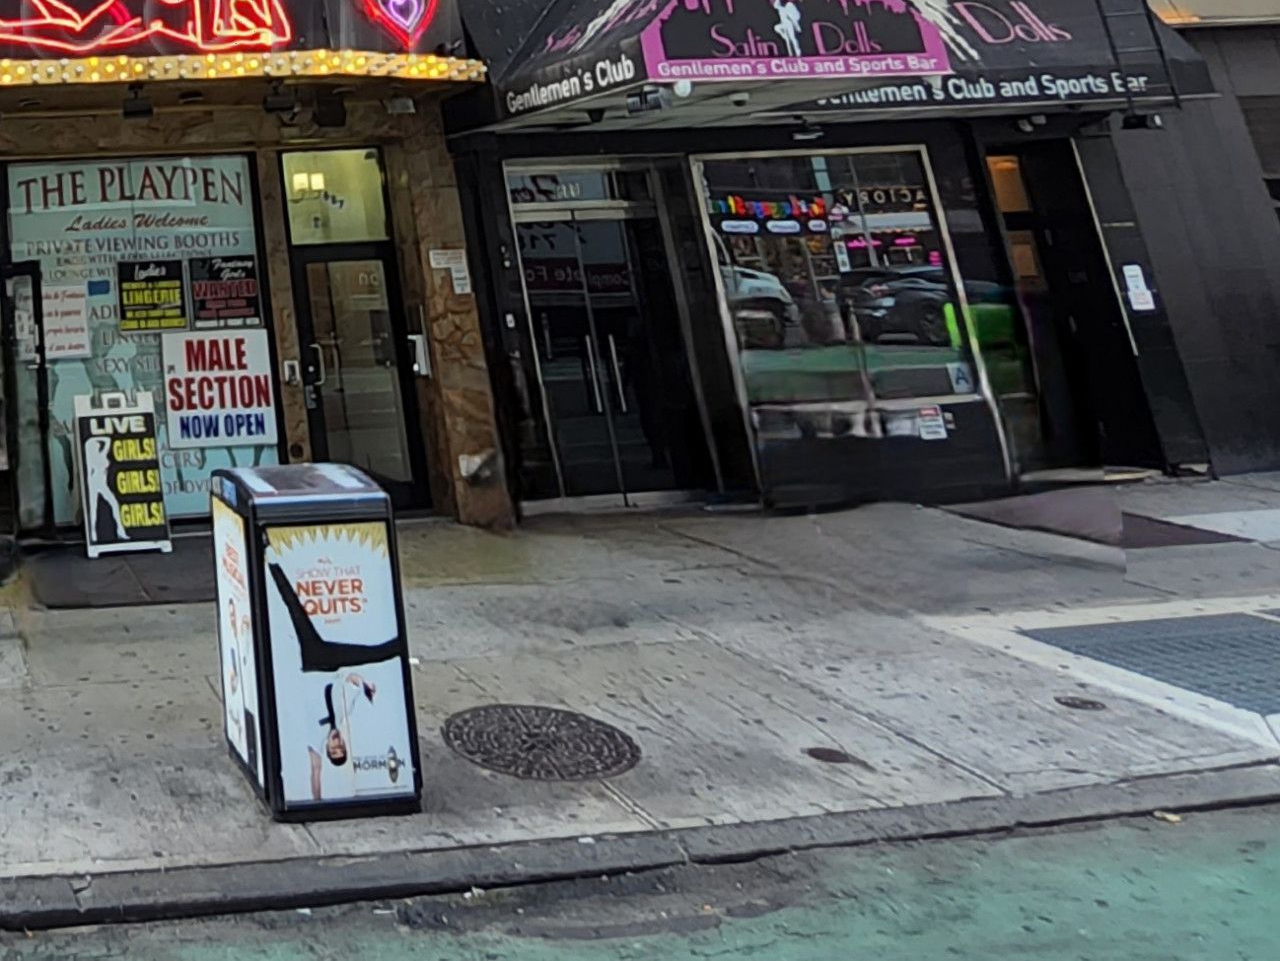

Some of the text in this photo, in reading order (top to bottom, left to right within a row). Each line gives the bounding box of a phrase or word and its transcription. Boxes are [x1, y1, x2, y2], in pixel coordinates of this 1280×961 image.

[953, 0, 1073, 43] Dolls
[710, 21, 883, 57] Satin Dolls
[595, 53, 635, 87] Club
[770, 57, 808, 75] Club
[814, 57, 846, 74] and
[851, 56, 904, 76] Sports
[909, 53, 937, 70] Bar
[947, 76, 995, 100] Club
[1000, 76, 1038, 97] and
[1042, 73, 1108, 101] Sports
[17, 164, 244, 214] THE PLAYPEN
[65, 212, 209, 232] Ladies Welcome
[26, 232, 240, 257] PRIVATE VIEWING BOOTHS
[185, 338, 248, 373] MALE
[168, 374, 271, 412] SECTION
[89, 415, 147, 436] LIVE
[179, 413, 266, 439] NOW OPEN
[113, 437, 156, 462] GIRLS!
[116, 468, 160, 494] GIRLS!
[120, 501, 165, 527] GIRLS!
[297, 579, 364, 597] NEVER
